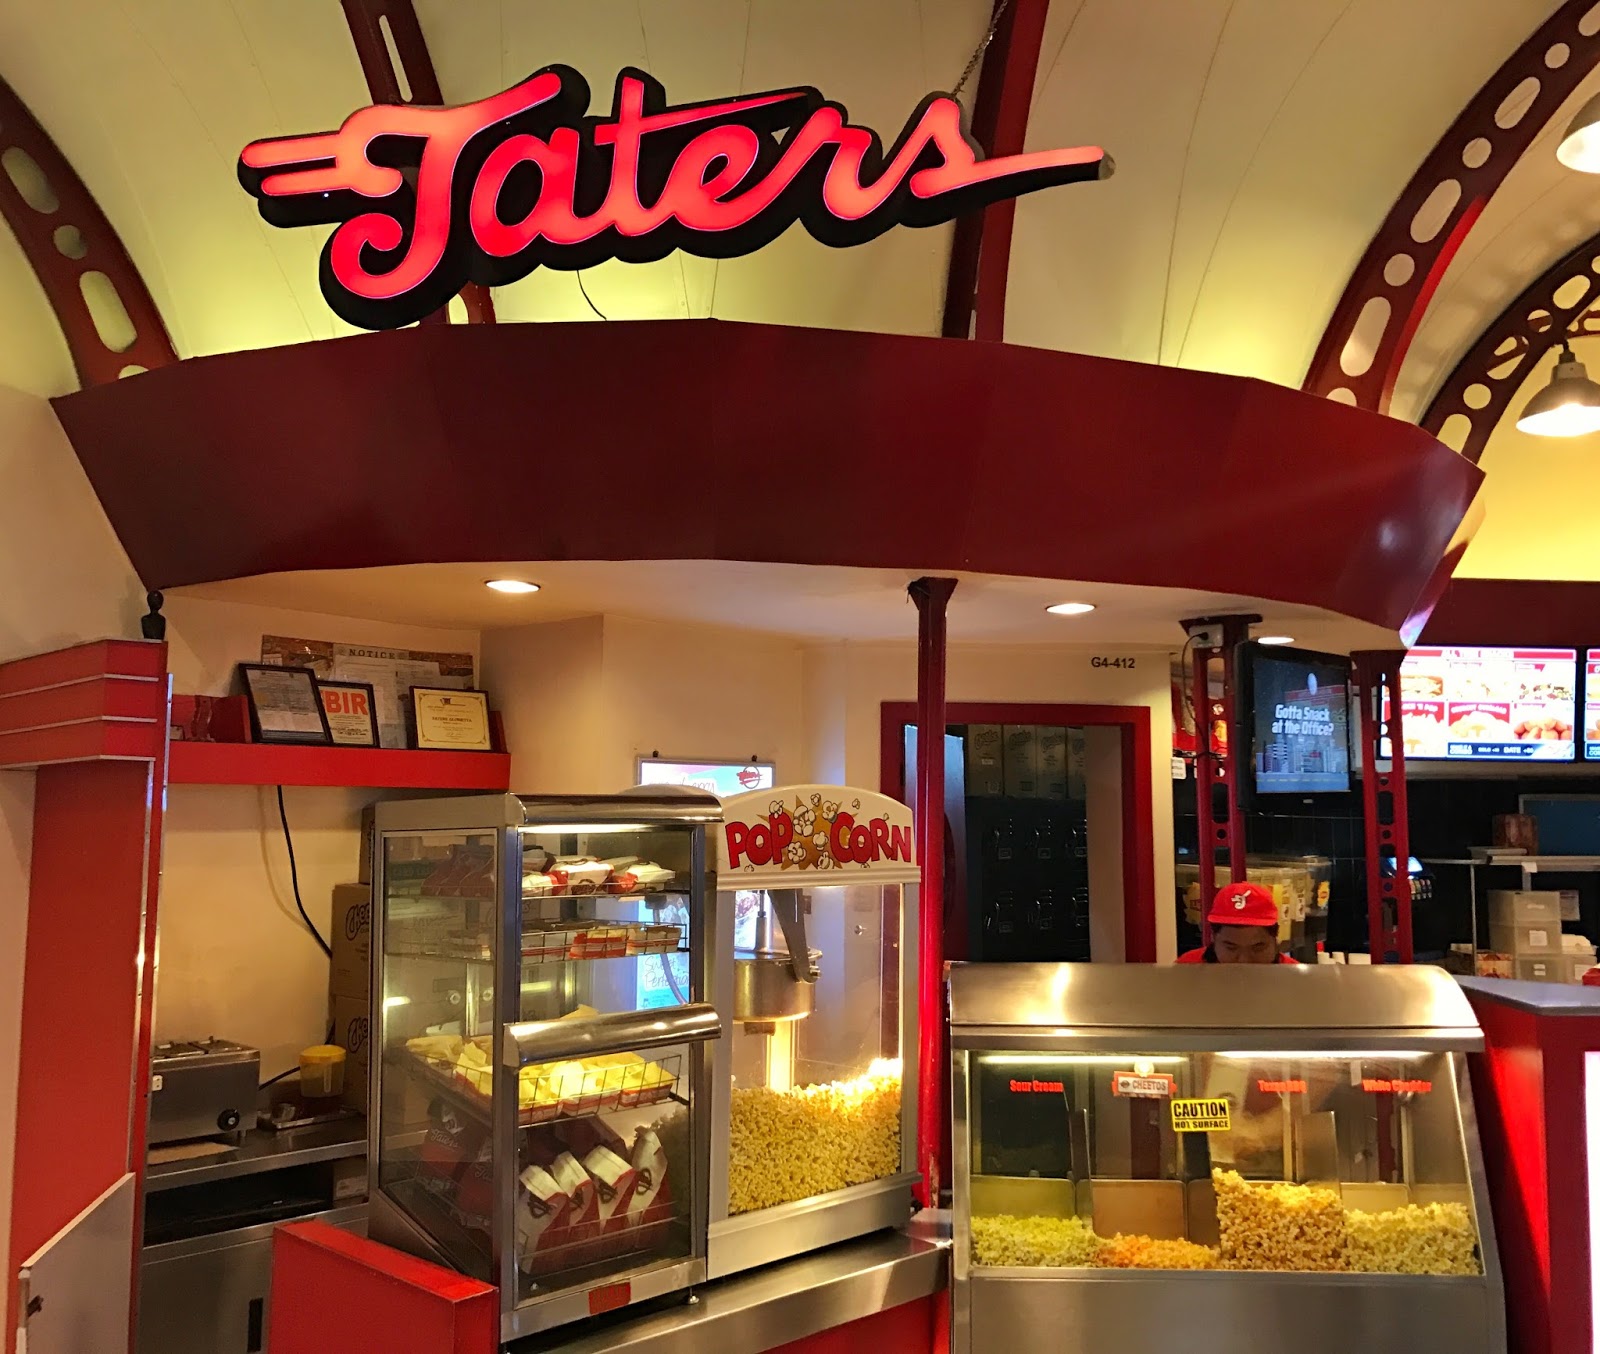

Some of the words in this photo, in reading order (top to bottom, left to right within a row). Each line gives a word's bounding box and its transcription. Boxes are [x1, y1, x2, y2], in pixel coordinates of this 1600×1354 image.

[240, 71, 1105, 299] Taters
[349, 648, 396, 660] NOTICE
[1091, 656, 1136, 669] G4-412
[324, 690, 369, 716] BIR
[1275, 704, 1302, 720] Gotta
[1303, 706, 1330, 721] Snack
[1271, 719, 1283, 734] at
[1284, 720, 1300, 734] the
[1301, 721, 1334, 736] Office?
[725, 812, 793, 869] POP
[830, 812, 911, 864] CORN
[1010, 1079, 1032, 1092] Sour
[1033, 1080, 1063, 1093] Cream
[1132, 1079, 1167, 1092] CHEETOS
[1174, 1101, 1227, 1118] CAUTION
[1175, 1120, 1191, 1129] HOT
[1193, 1119, 1229, 1129] SURFACE
